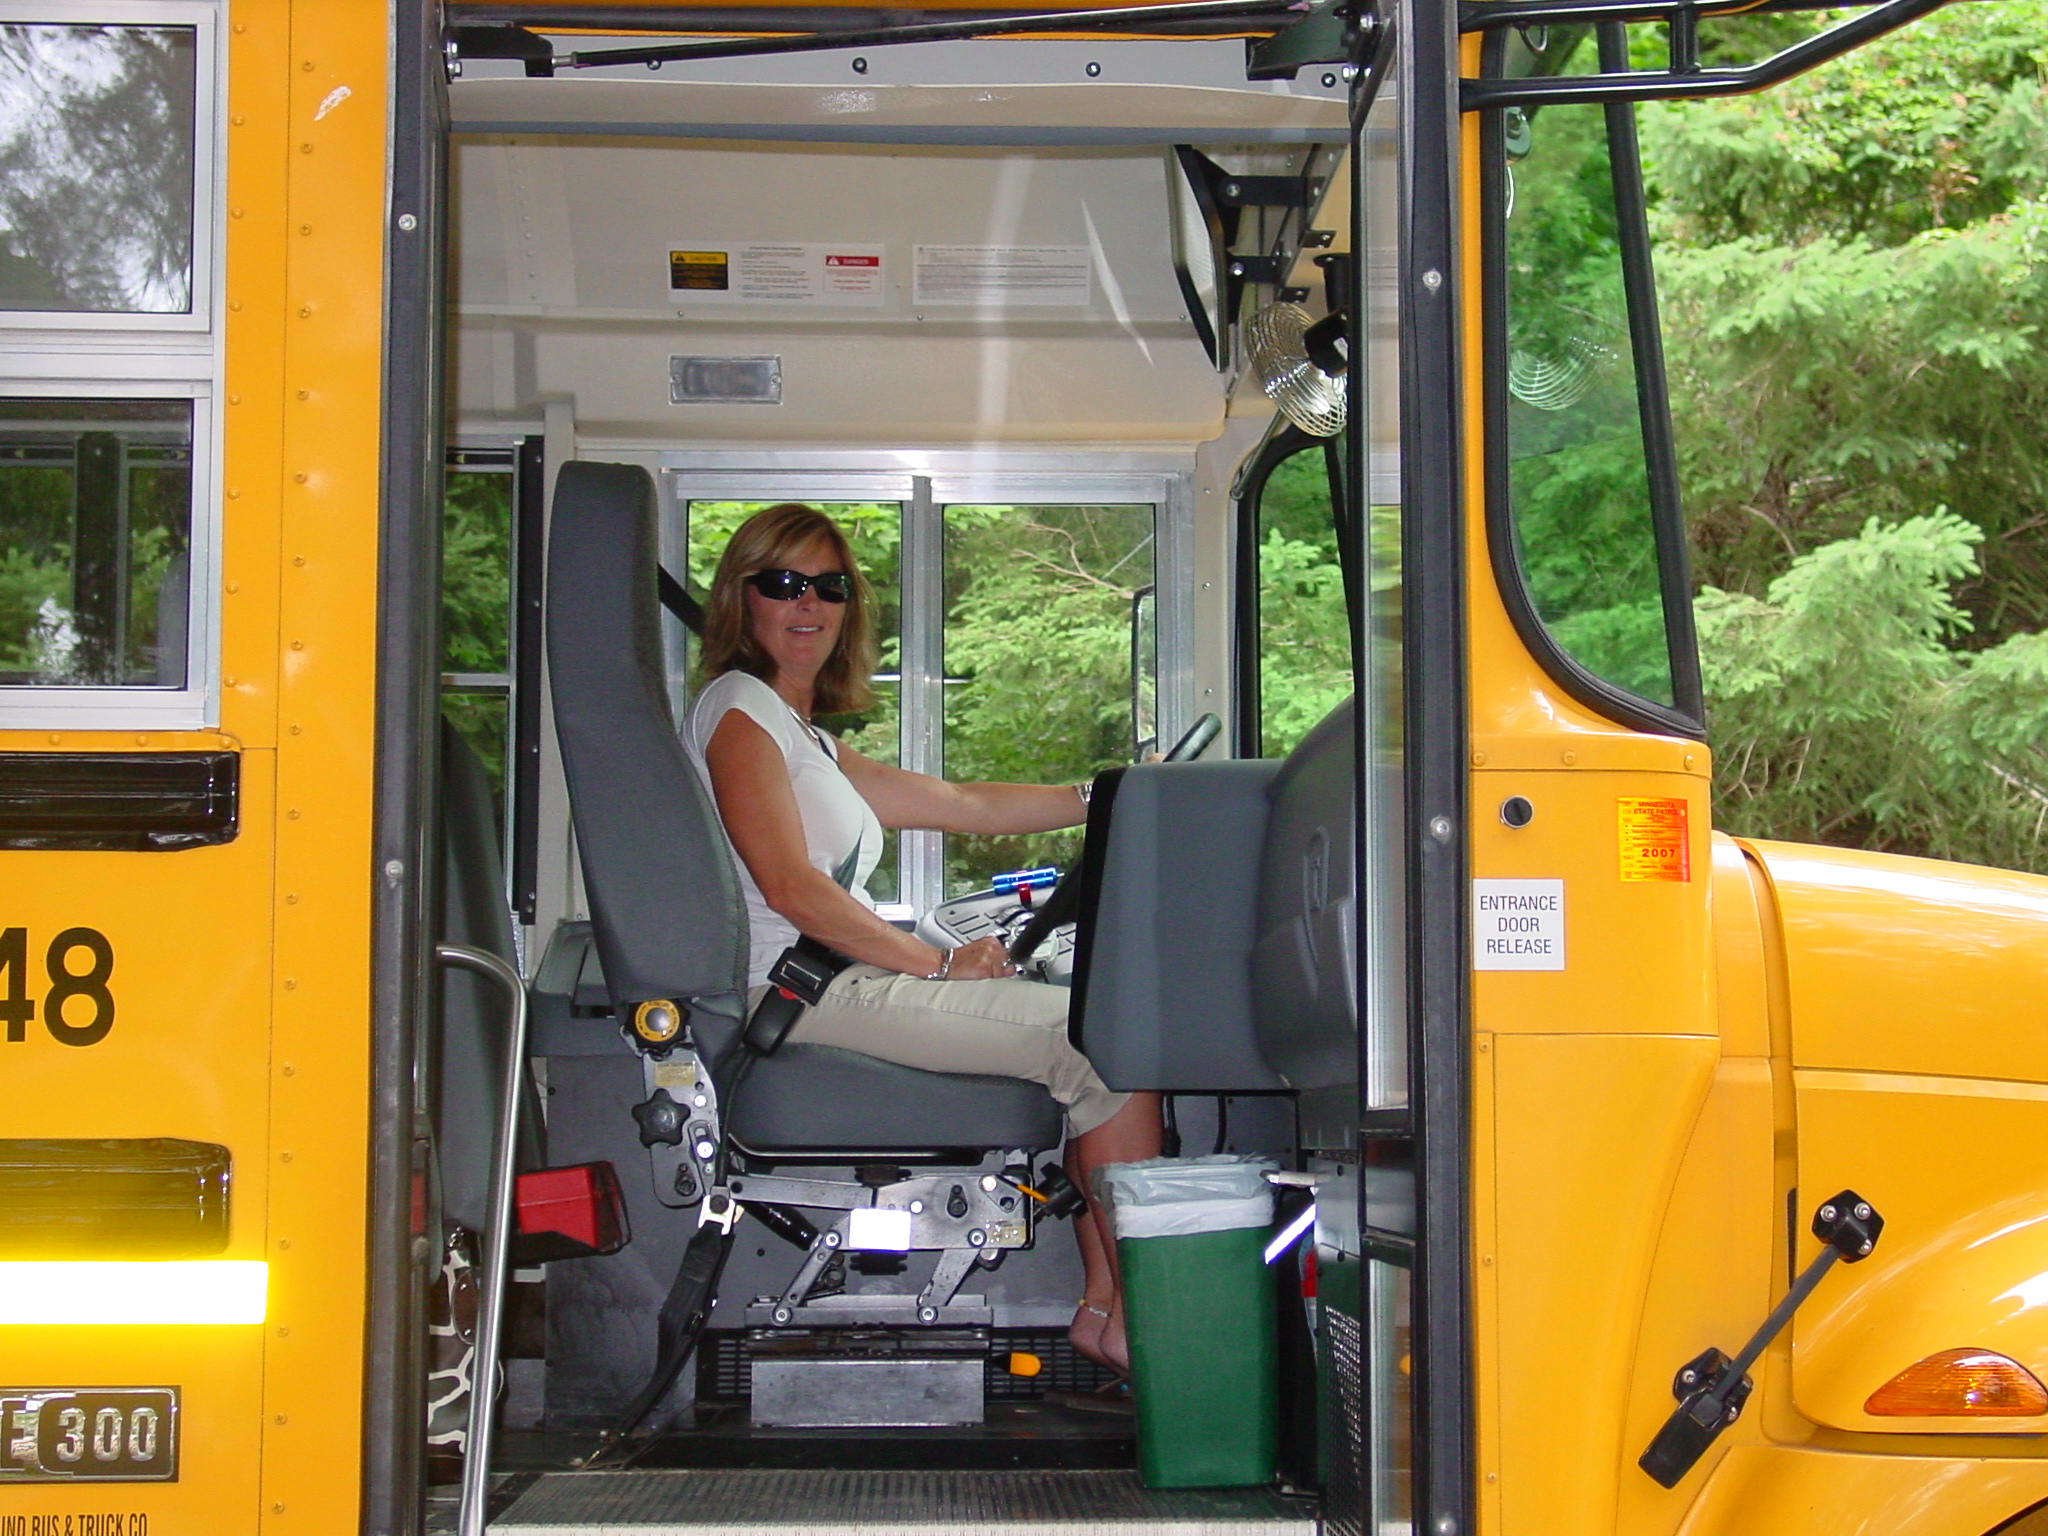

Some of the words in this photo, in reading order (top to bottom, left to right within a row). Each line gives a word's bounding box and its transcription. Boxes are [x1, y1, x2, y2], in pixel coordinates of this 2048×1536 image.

[1641, 848, 1676, 858] 2007
[1480, 895, 1557, 911] ENTRANCE
[1498, 917, 1540, 932] DOOR
[1486, 938, 1552, 954] RELEASE
[56, 1407, 157, 1462] 300
[32, 1515, 60, 1536] BUS
[64, 1514, 74, 1536] &
[78, 1513, 124, 1536] TRUCK
[129, 1513, 148, 1536] CO
